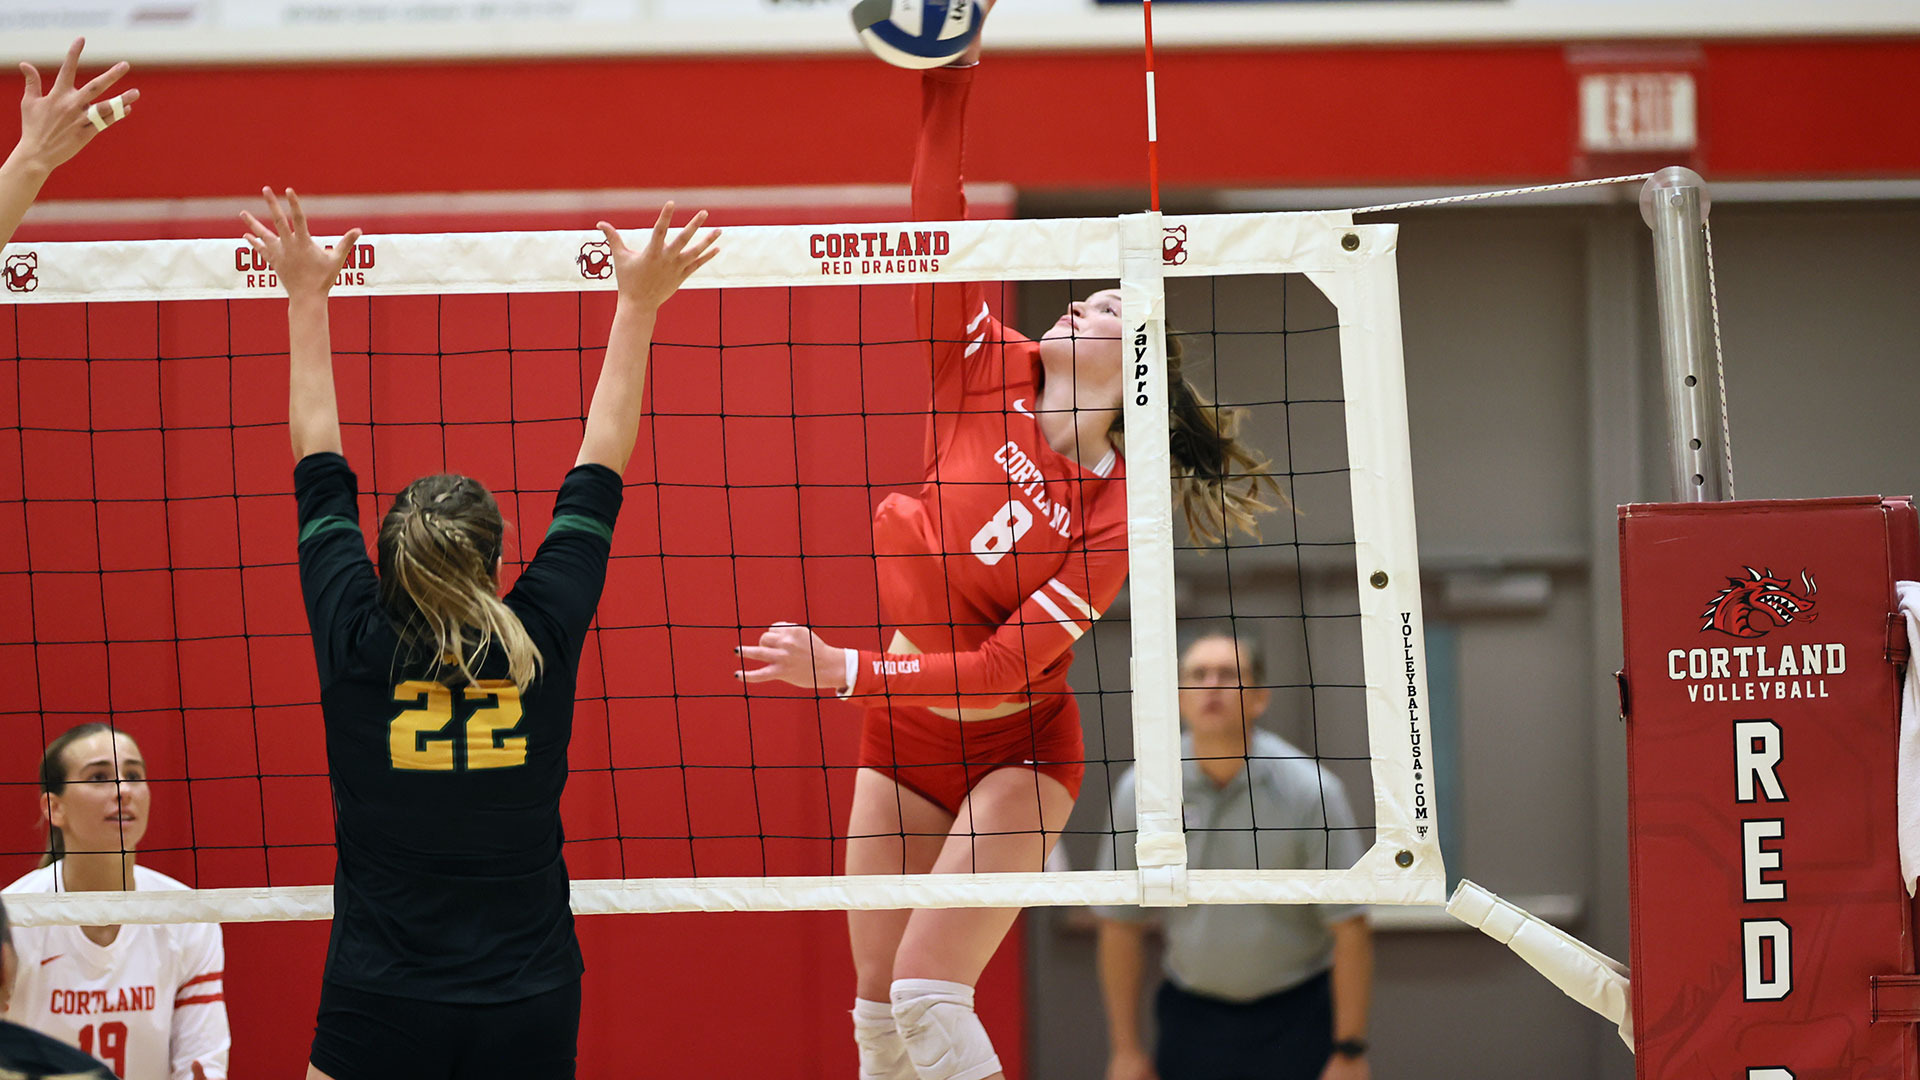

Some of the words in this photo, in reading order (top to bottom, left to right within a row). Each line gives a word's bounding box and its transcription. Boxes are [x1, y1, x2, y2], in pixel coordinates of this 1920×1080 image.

[235, 244, 375, 271] COND
[810, 231, 949, 259] CORTLAND
[247, 274, 277, 288] RED
[821, 261, 852, 275] RED
[861, 259, 940, 274] DRAGONS
[970, 499, 1033, 566] 8
[1667, 642, 1847, 681] CORTLAND
[1687, 680, 1829, 702] VOLLEYBALL
[387, 679, 530, 772] 22
[1733, 719, 1795, 1002] RED
[50, 985, 155, 1015] CORTLAND
[78, 1020, 128, 1080] 19
